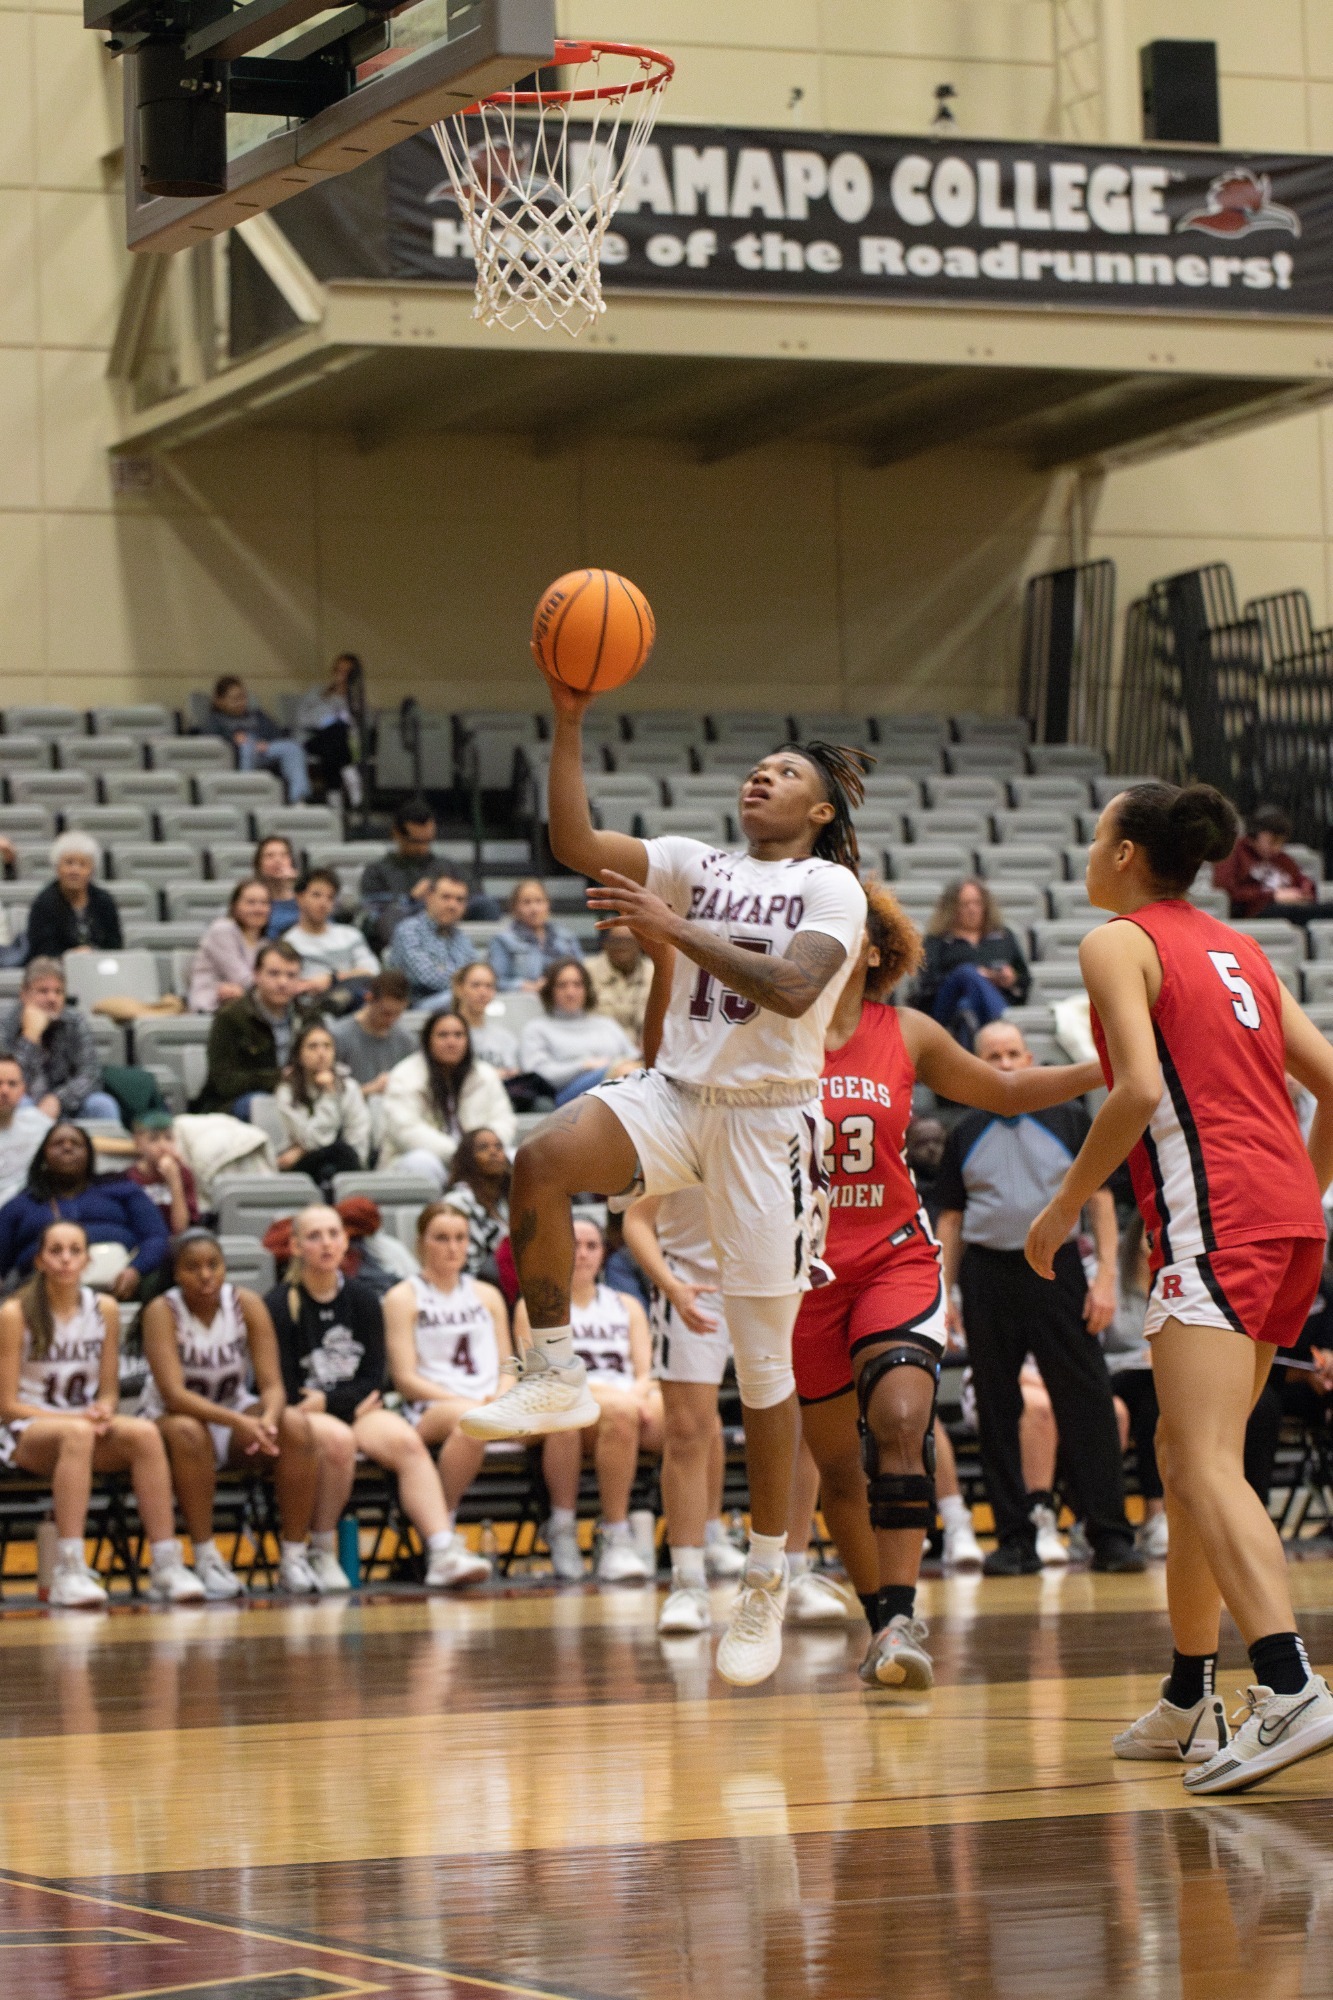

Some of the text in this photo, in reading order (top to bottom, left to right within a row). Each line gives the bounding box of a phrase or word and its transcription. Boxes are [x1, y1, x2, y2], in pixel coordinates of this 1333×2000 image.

[569, 140, 1171, 236] RAMAPO COLLEGE
[432, 218, 1294, 290] He of the Roadrunners!
[685, 885, 804, 931] RAMAPO
[1206, 950, 1262, 1031] 5
[818, 1075, 891, 1108] TGERS
[828, 1184, 885, 1208] MDEN
[1162, 1274, 1187, 1300] R
[450, 1331, 479, 1376] 4
